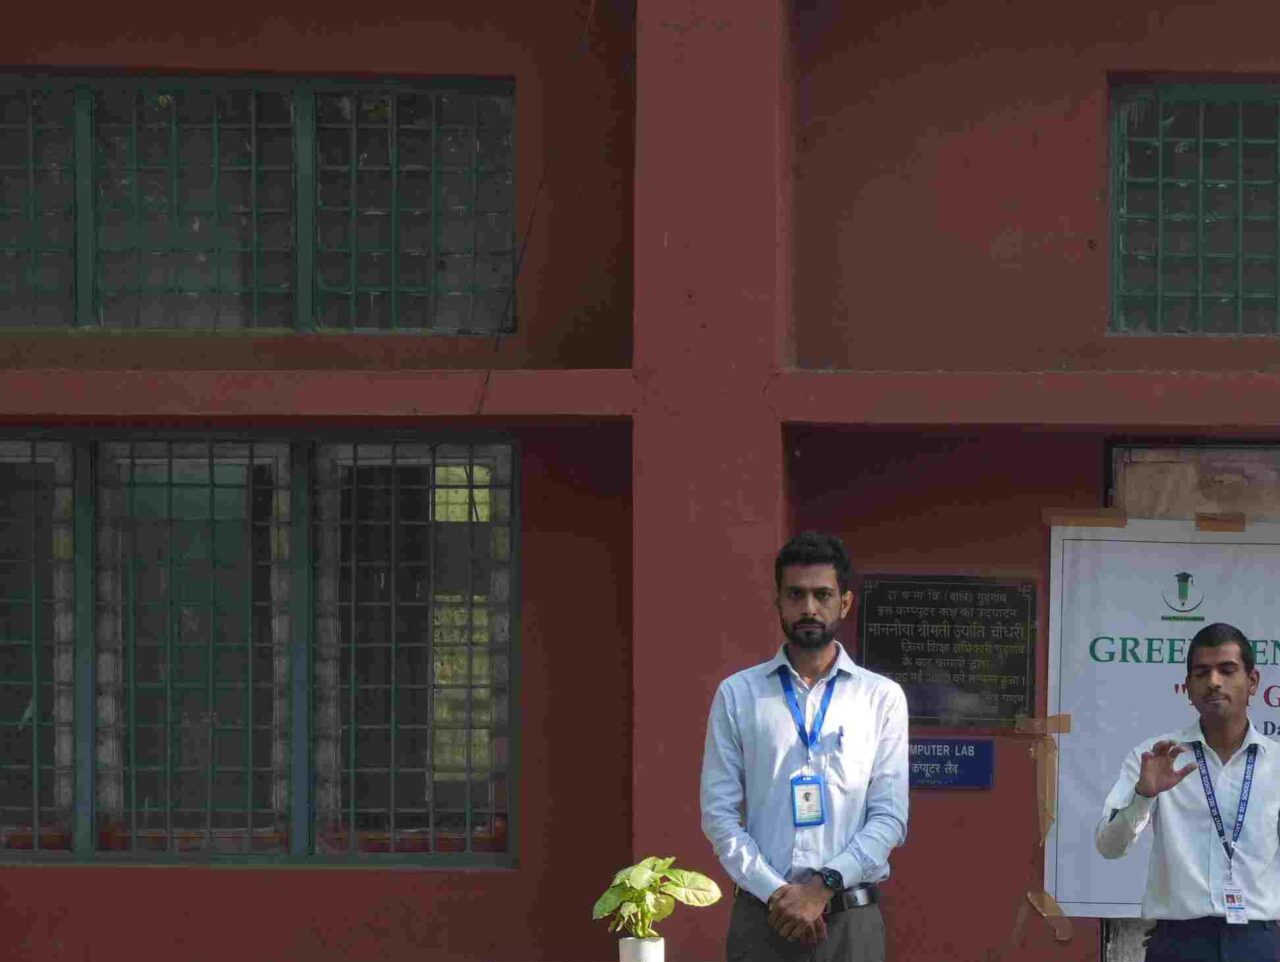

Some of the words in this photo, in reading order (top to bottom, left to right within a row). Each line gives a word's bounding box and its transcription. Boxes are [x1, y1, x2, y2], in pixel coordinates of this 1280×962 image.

[1089, 636, 1190, 664] GREE
[910, 744, 950, 757] MPUTER
[955, 745, 975, 757] LAB
